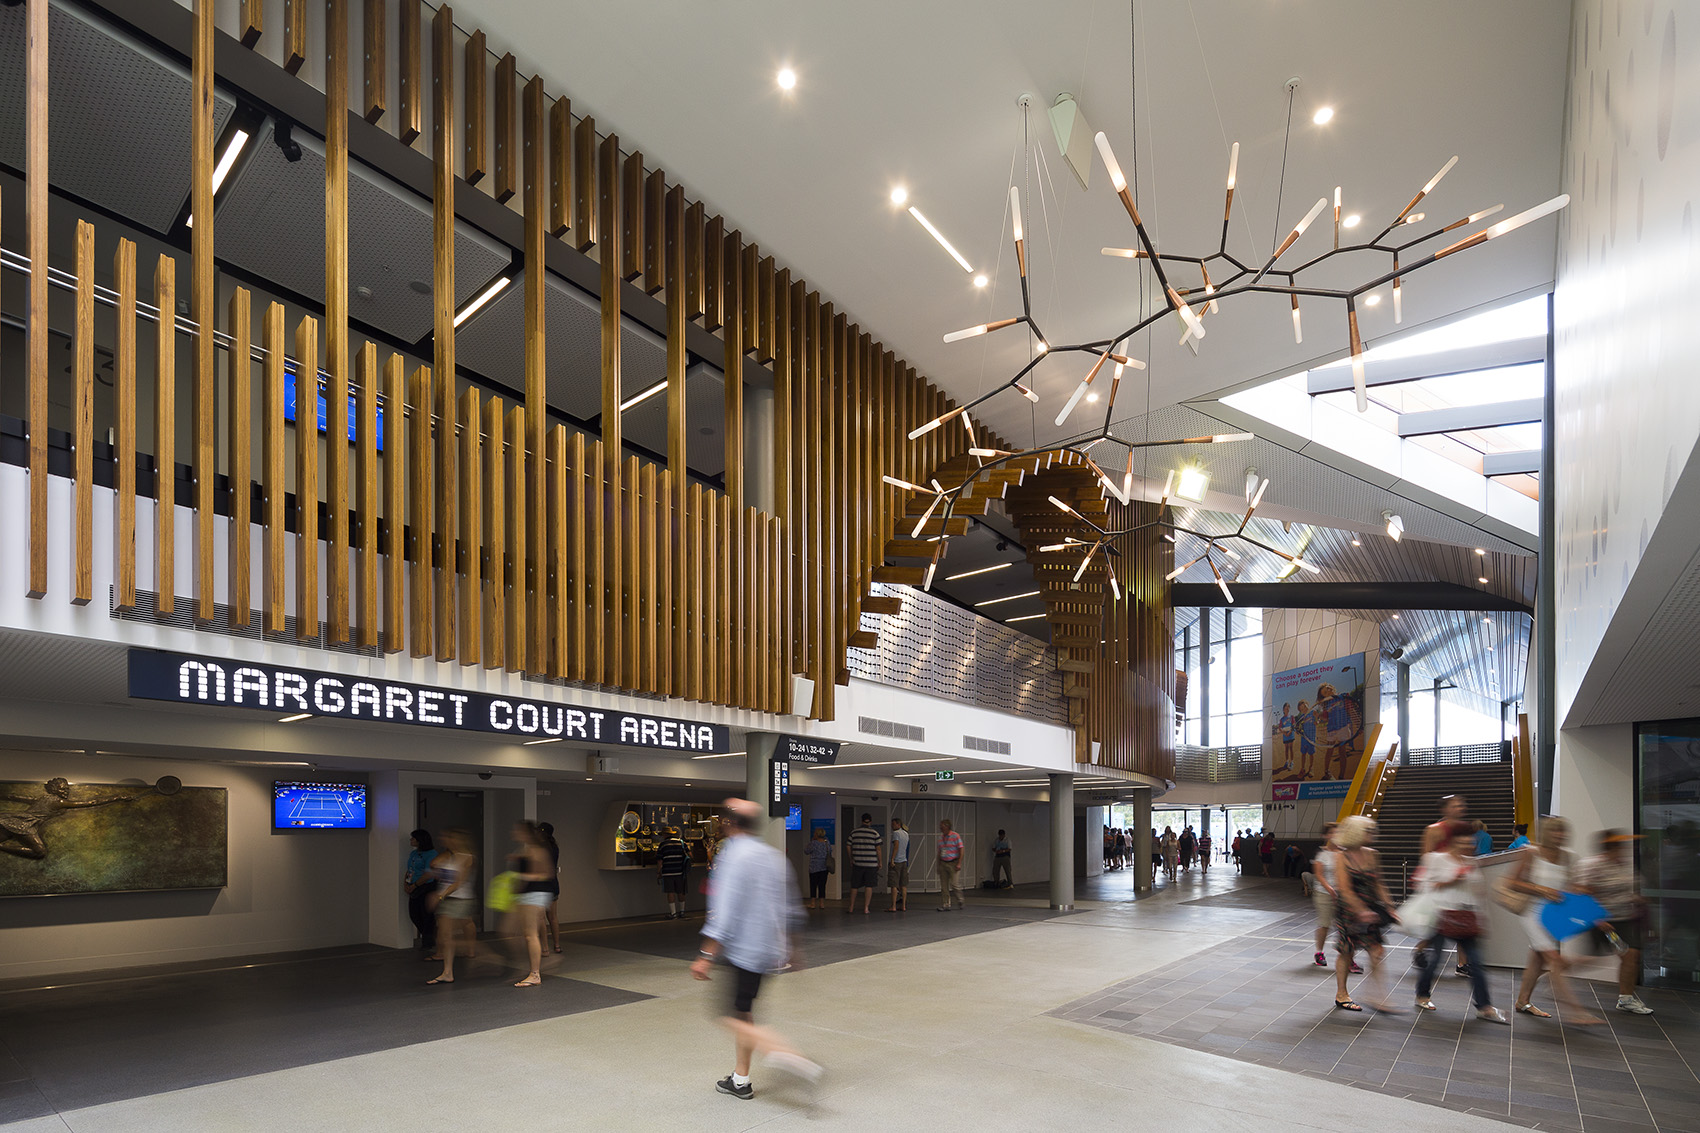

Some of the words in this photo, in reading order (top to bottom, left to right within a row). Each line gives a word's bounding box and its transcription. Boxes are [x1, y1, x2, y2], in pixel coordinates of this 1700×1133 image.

[1276, 674, 1296, 683] Choose
[1303, 668, 1318, 677] sport
[1287, 680, 1298, 688] play
[1300, 675, 1321, 683] forever
[179, 660, 468, 725] MARGARET
[489, 700, 604, 740] COURT
[620, 716, 713, 751] ARENA
[789, 743, 805, 752] 10-24
[810, 745, 825, 755] 32-42
[789, 752, 800, 760] Food
[599, 759, 603, 771] 1
[919, 783, 928, 792] 20
